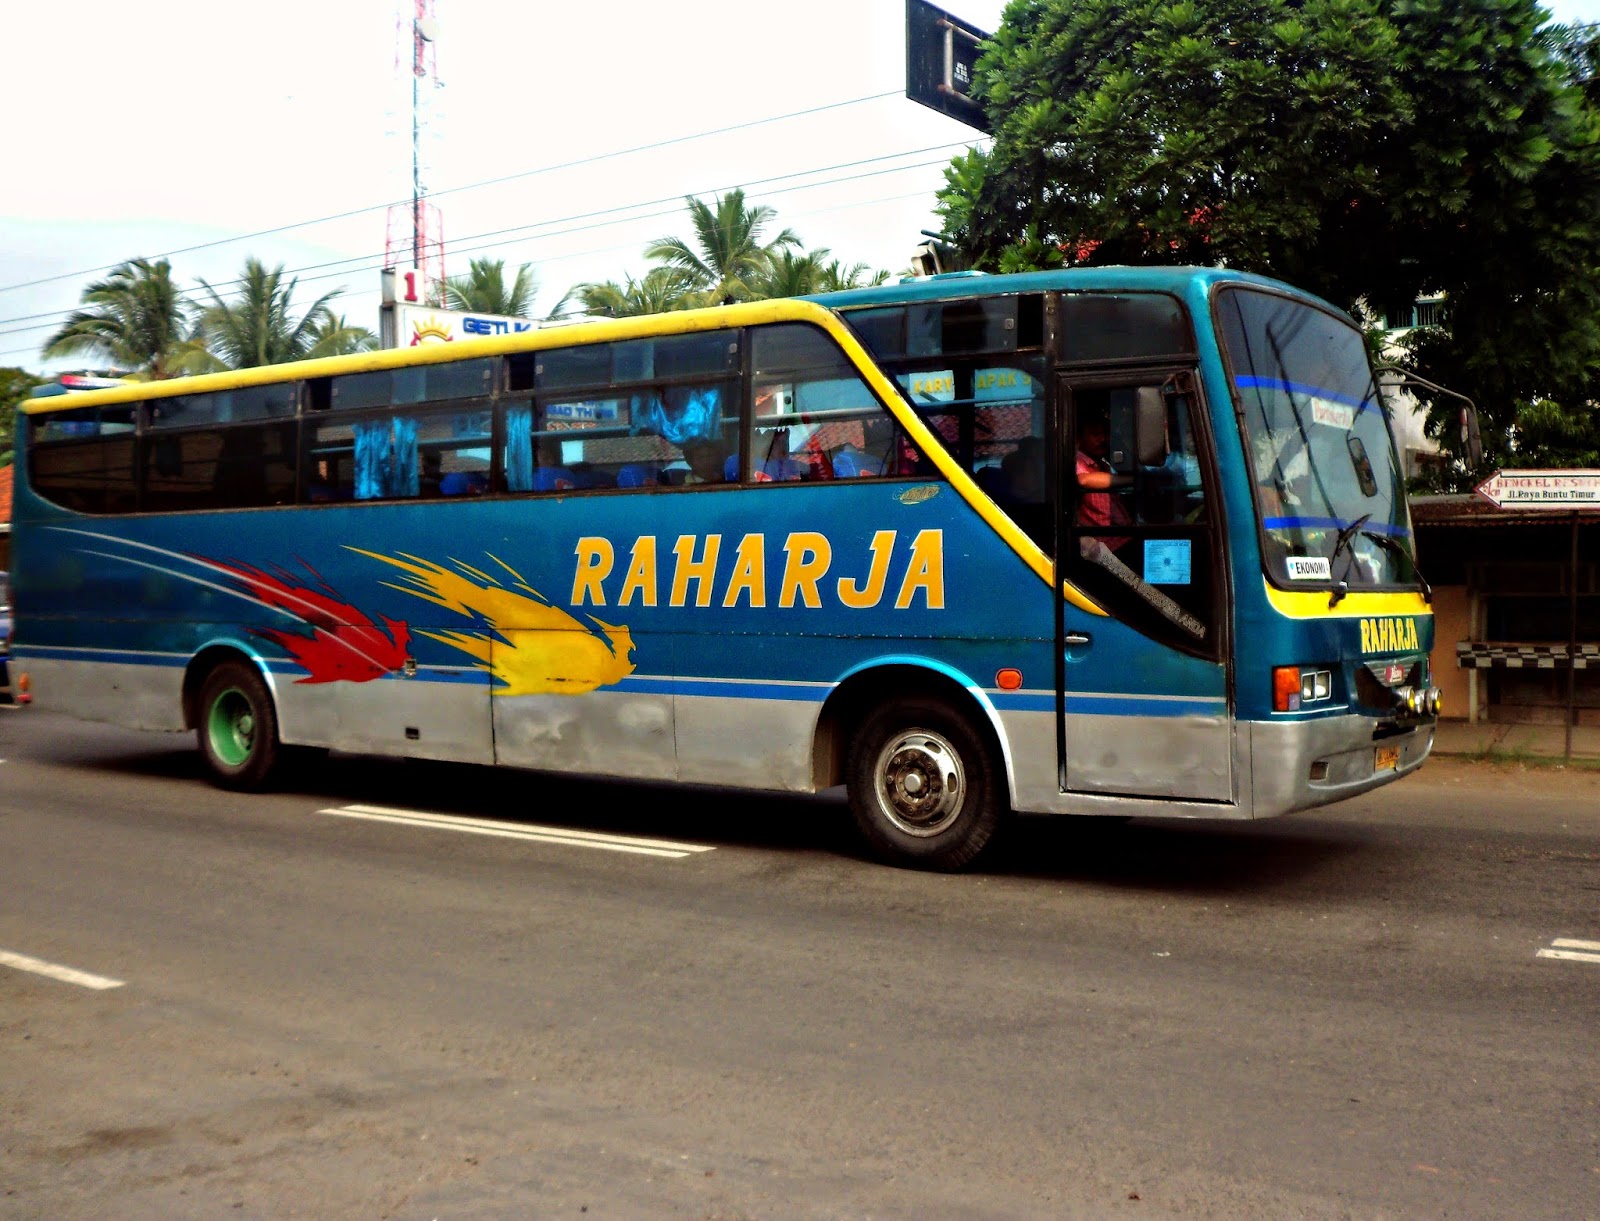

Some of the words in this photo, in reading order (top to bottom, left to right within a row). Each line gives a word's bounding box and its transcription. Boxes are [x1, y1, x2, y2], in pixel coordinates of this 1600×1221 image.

[1542, 490, 1568, 499] Buntu
[1570, 490, 1595, 499] Timur
[570, 528, 946, 610] RAHARJA
[1360, 617, 1419, 653] RAHARJA
